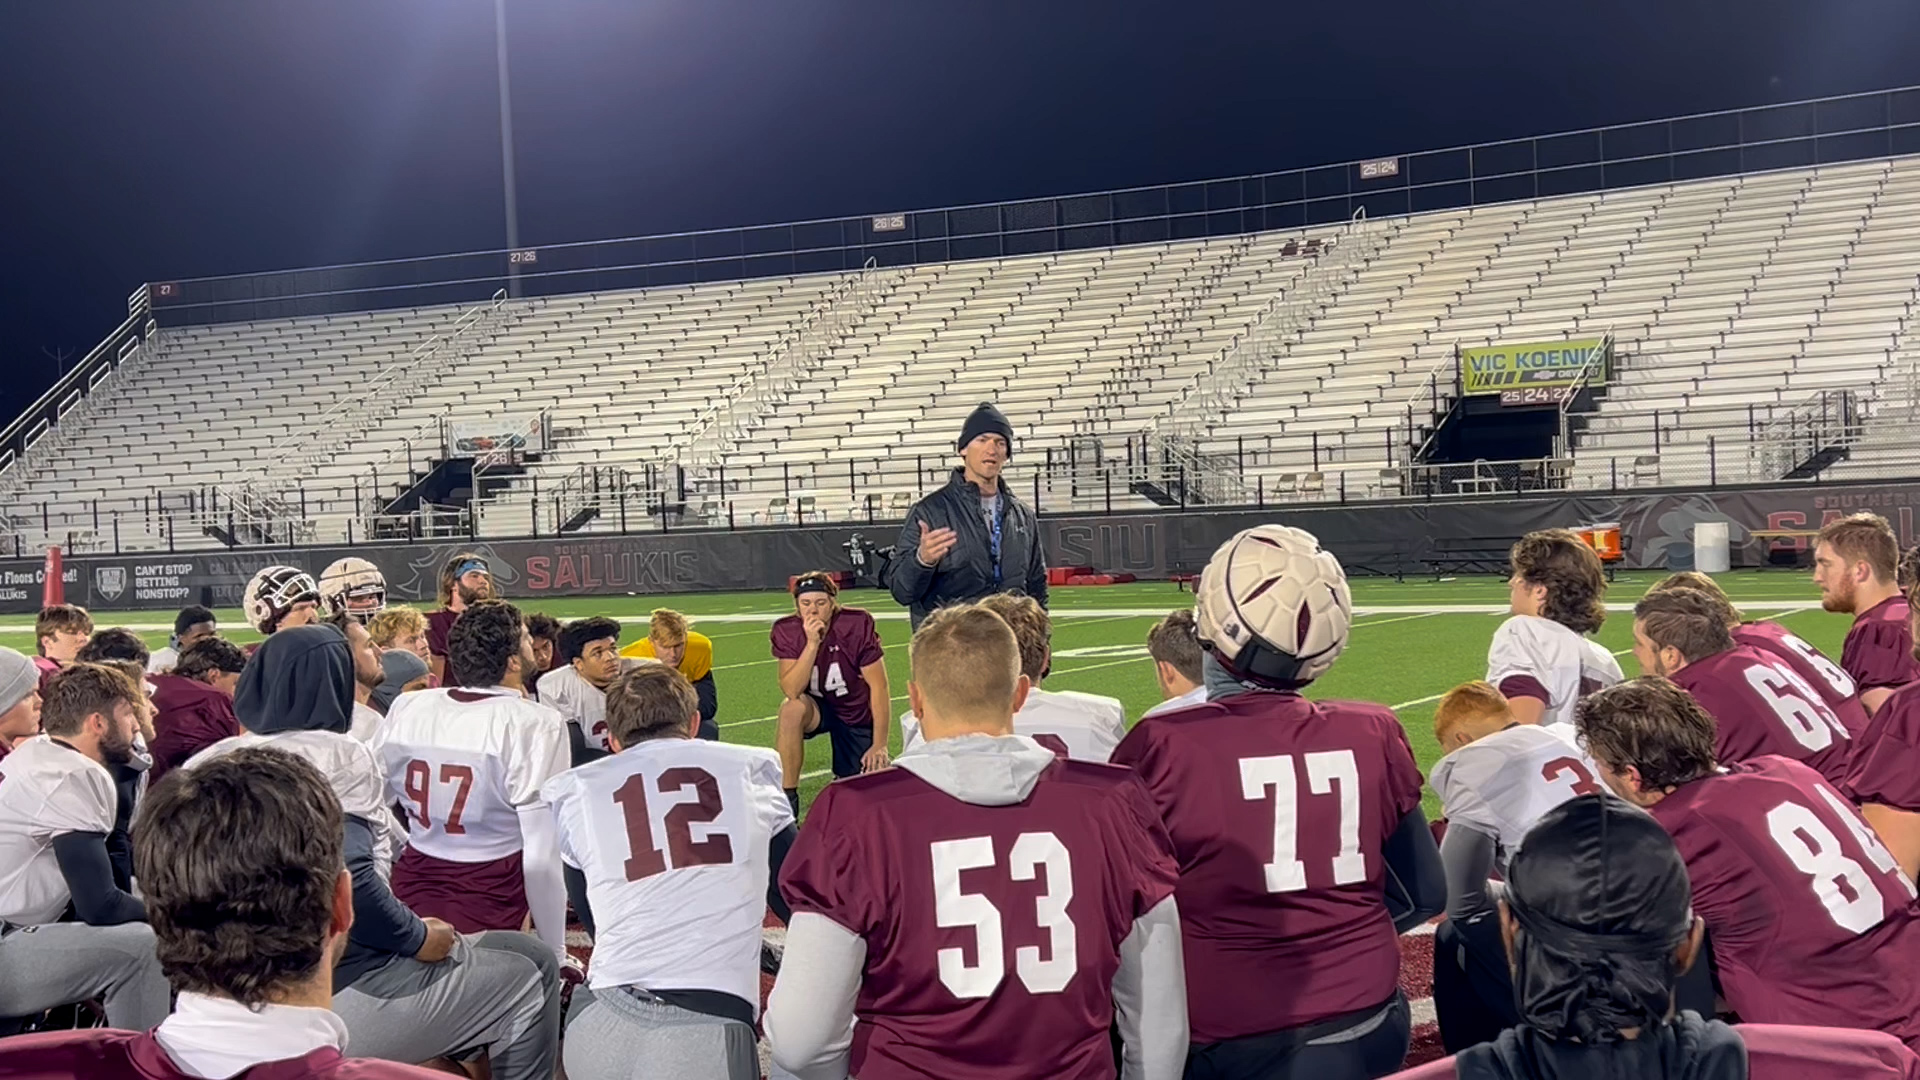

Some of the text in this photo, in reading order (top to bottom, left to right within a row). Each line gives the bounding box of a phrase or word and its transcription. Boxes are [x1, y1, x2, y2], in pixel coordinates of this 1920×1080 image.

[1363, 161, 1396, 175] 25 24
[890, 216, 903, 228] 25
[510, 251, 536, 263] 27 26
[160, 285, 170, 295] 27
[1470, 353, 1506, 372] VIC
[1502, 391, 1520, 402] 25
[1524, 387, 1549, 402] 24
[1058, 523, 1157, 571] SIU
[4, 571, 34, 585] Floors
[135, 563, 193, 576] CAN'T STOP
[526, 551, 699, 590] SALUKIS
[135, 576, 179, 588] BETTING
[136, 587, 189, 599] NONSTOP?
[810, 661, 849, 698] 14
[404, 758, 474, 834] 97
[612, 766, 733, 883] 12
[1238, 749, 1367, 893] 77
[1766, 783, 1919, 935] 84
[930, 831, 1078, 999] 53
